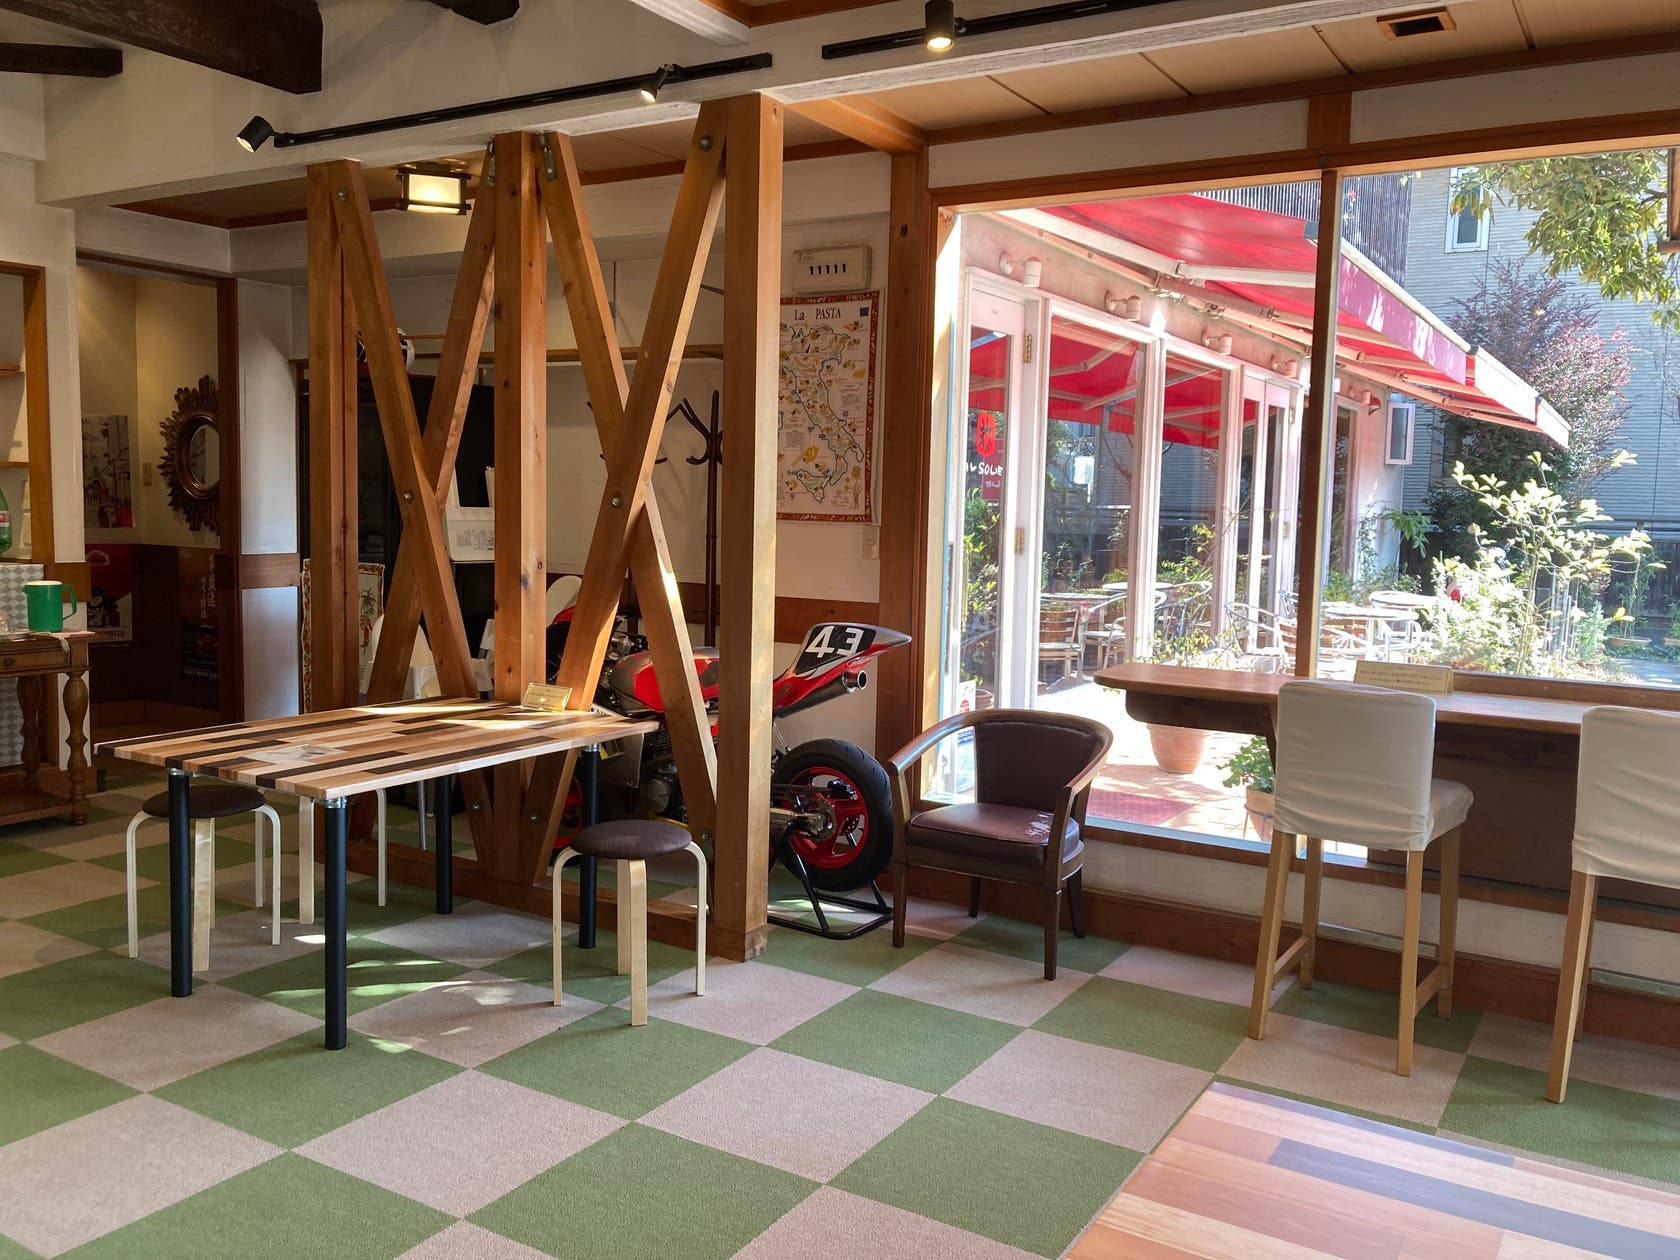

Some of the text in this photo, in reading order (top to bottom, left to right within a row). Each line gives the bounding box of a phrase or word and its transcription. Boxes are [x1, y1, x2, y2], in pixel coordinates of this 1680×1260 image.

[794, 307, 842, 321] La PASTA
[978, 462, 1003, 476] SOLE
[805, 625, 864, 658] 43
